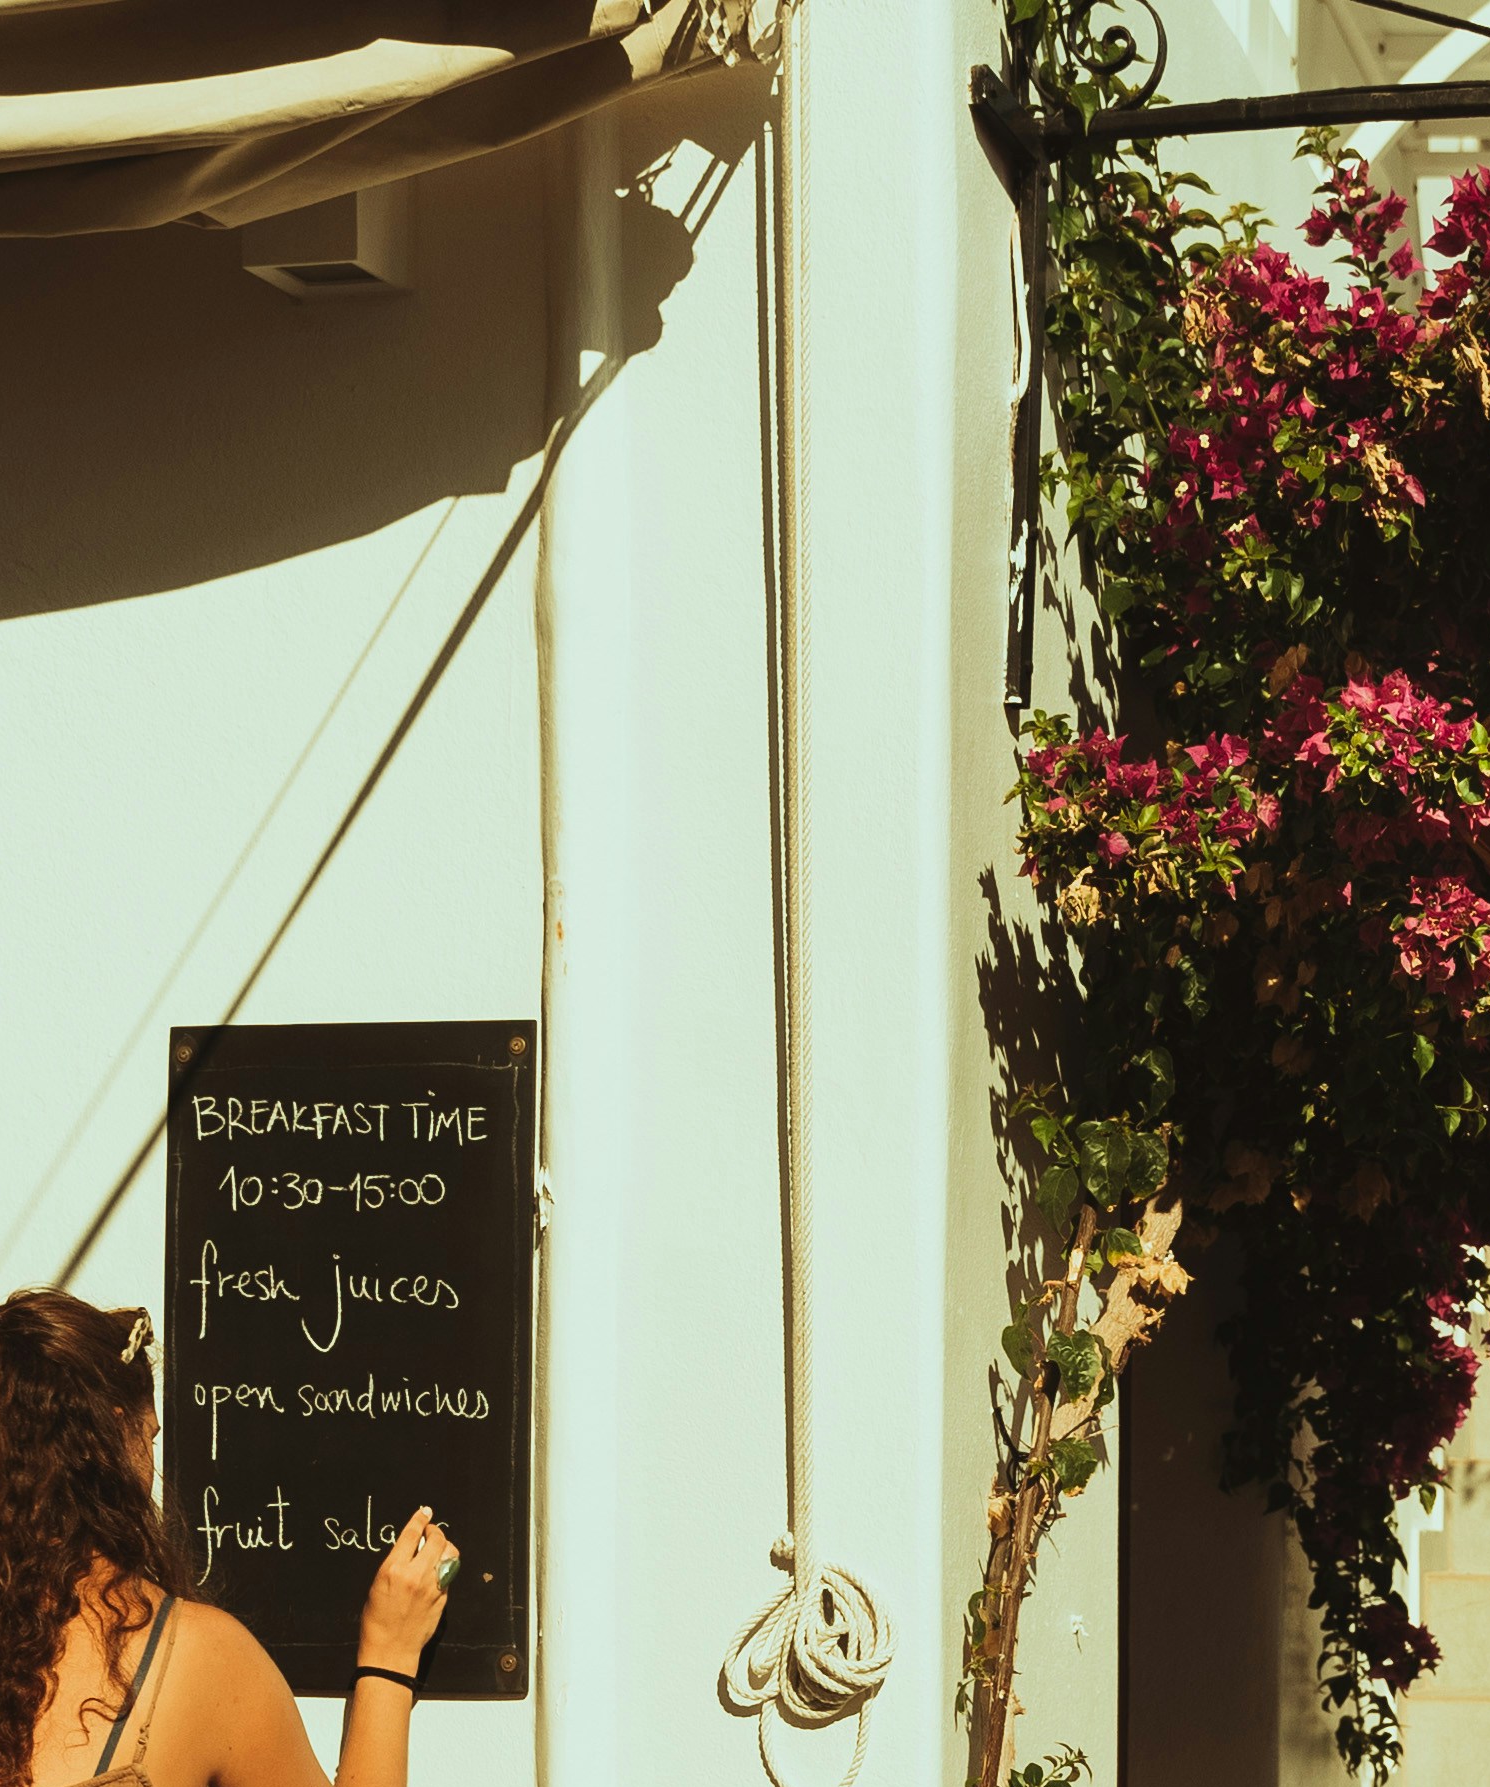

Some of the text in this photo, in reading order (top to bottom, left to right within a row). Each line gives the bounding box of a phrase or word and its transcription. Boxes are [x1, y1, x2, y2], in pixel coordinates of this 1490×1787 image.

[192, 1096, 390, 1142] BREAKFAST
[219, 1166, 446, 1212] 10:30-15:00
[190, 1240, 460, 1353] fresh juices
[195, 1374, 490, 1461] open sandwiches
[197, 1486, 294, 1587] fruit
